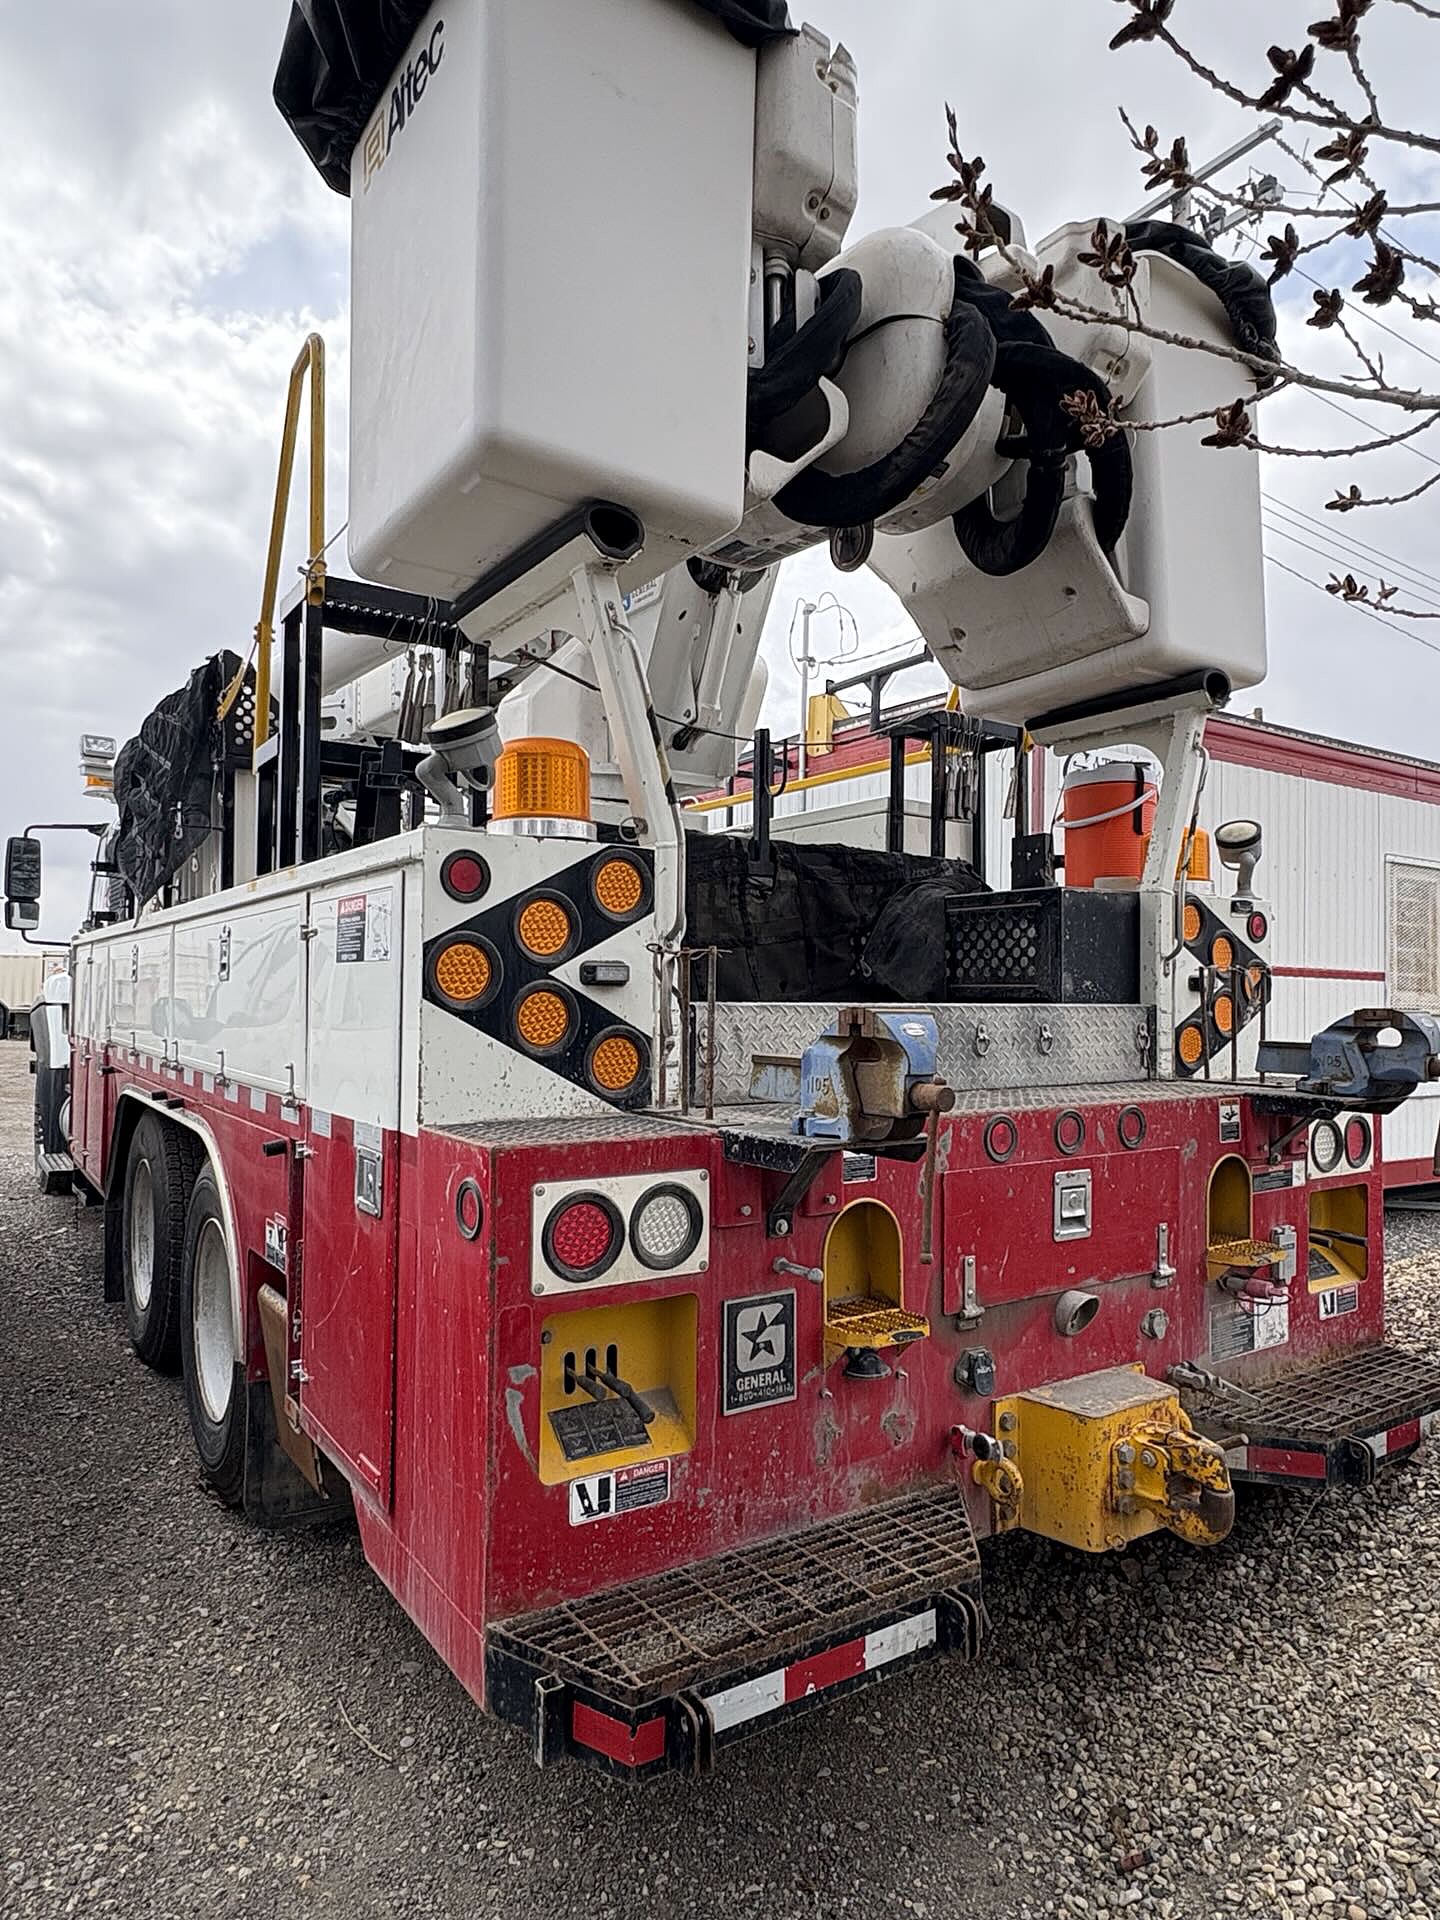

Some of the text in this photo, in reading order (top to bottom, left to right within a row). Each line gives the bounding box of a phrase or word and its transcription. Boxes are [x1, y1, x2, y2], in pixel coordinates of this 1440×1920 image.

[386, 19, 445, 157] Altec
[806, 1075, 830, 1096] 1105
[736, 1369, 787, 1392] GENERAL
[632, 1462, 665, 1477] DANGER
